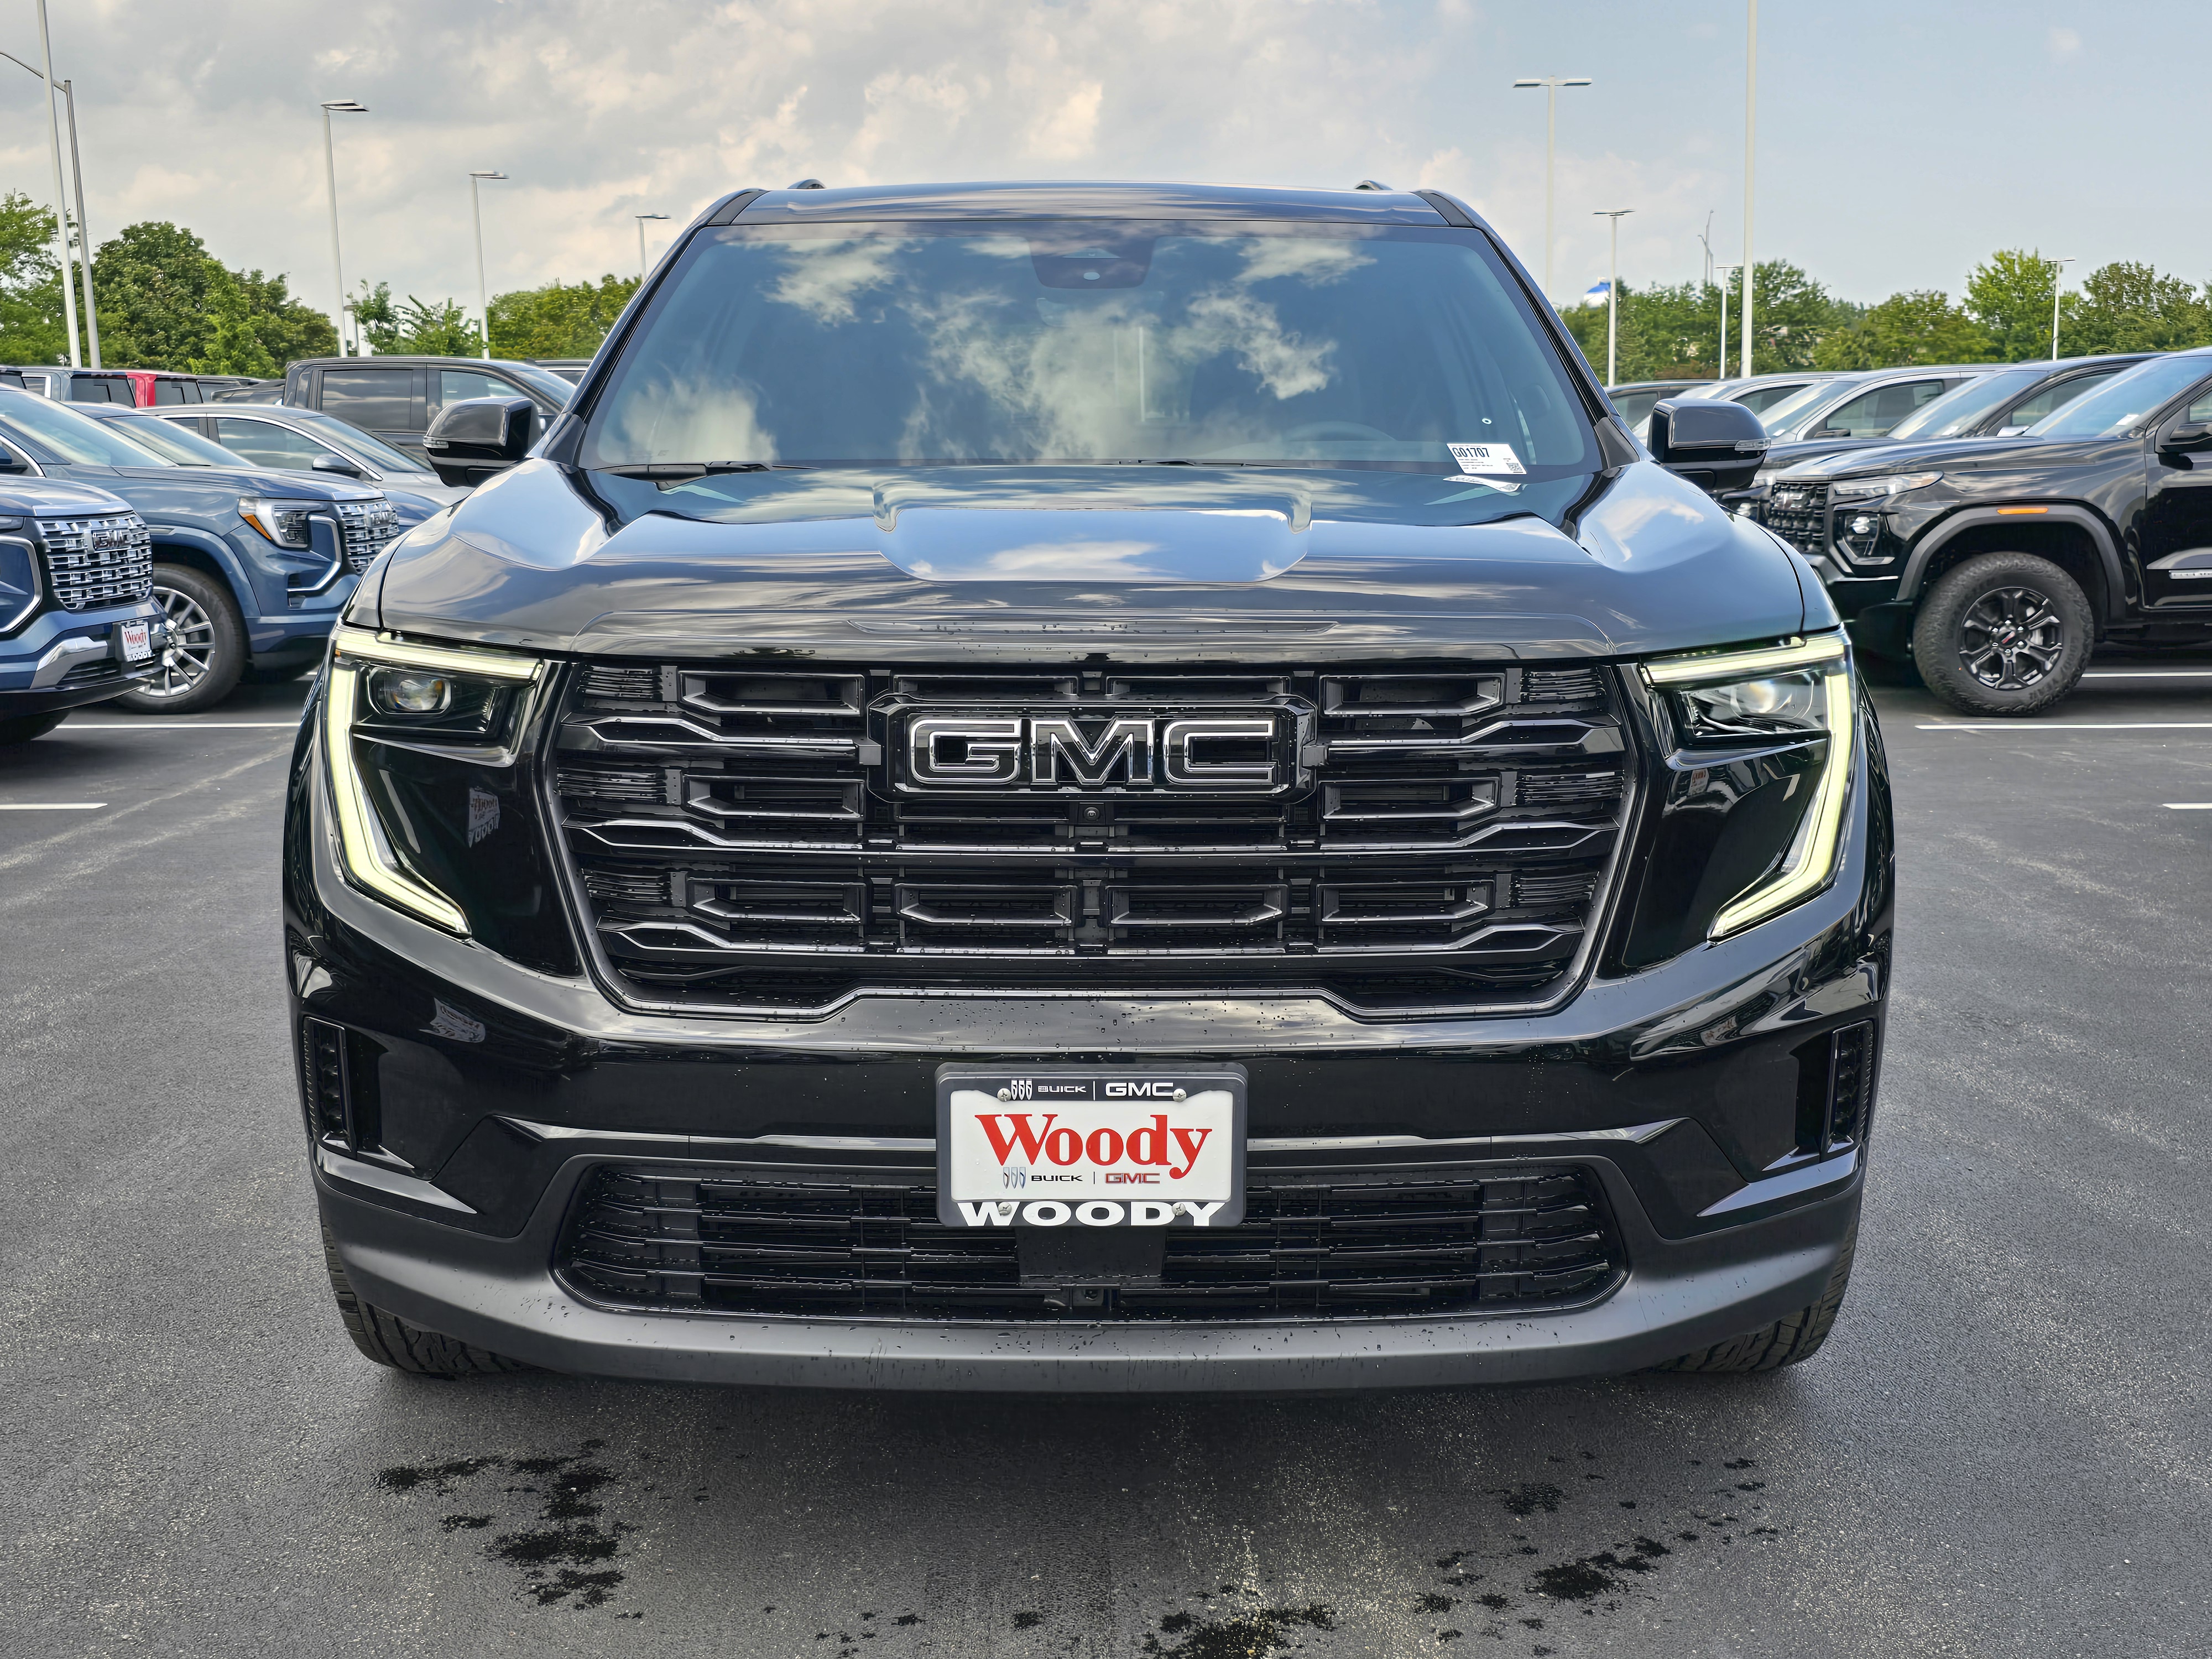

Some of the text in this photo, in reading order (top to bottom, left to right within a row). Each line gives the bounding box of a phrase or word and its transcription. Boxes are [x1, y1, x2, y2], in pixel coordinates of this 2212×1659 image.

[1452, 447, 1490, 458] G01707
[910, 718, 1274, 785] GMC
[1105, 1082, 1173, 1097] GMC
[974, 1113, 1213, 1180] Woody
[1105, 1173, 1160, 1184] GMC
[957, 1201, 1226, 1227] WOODY
